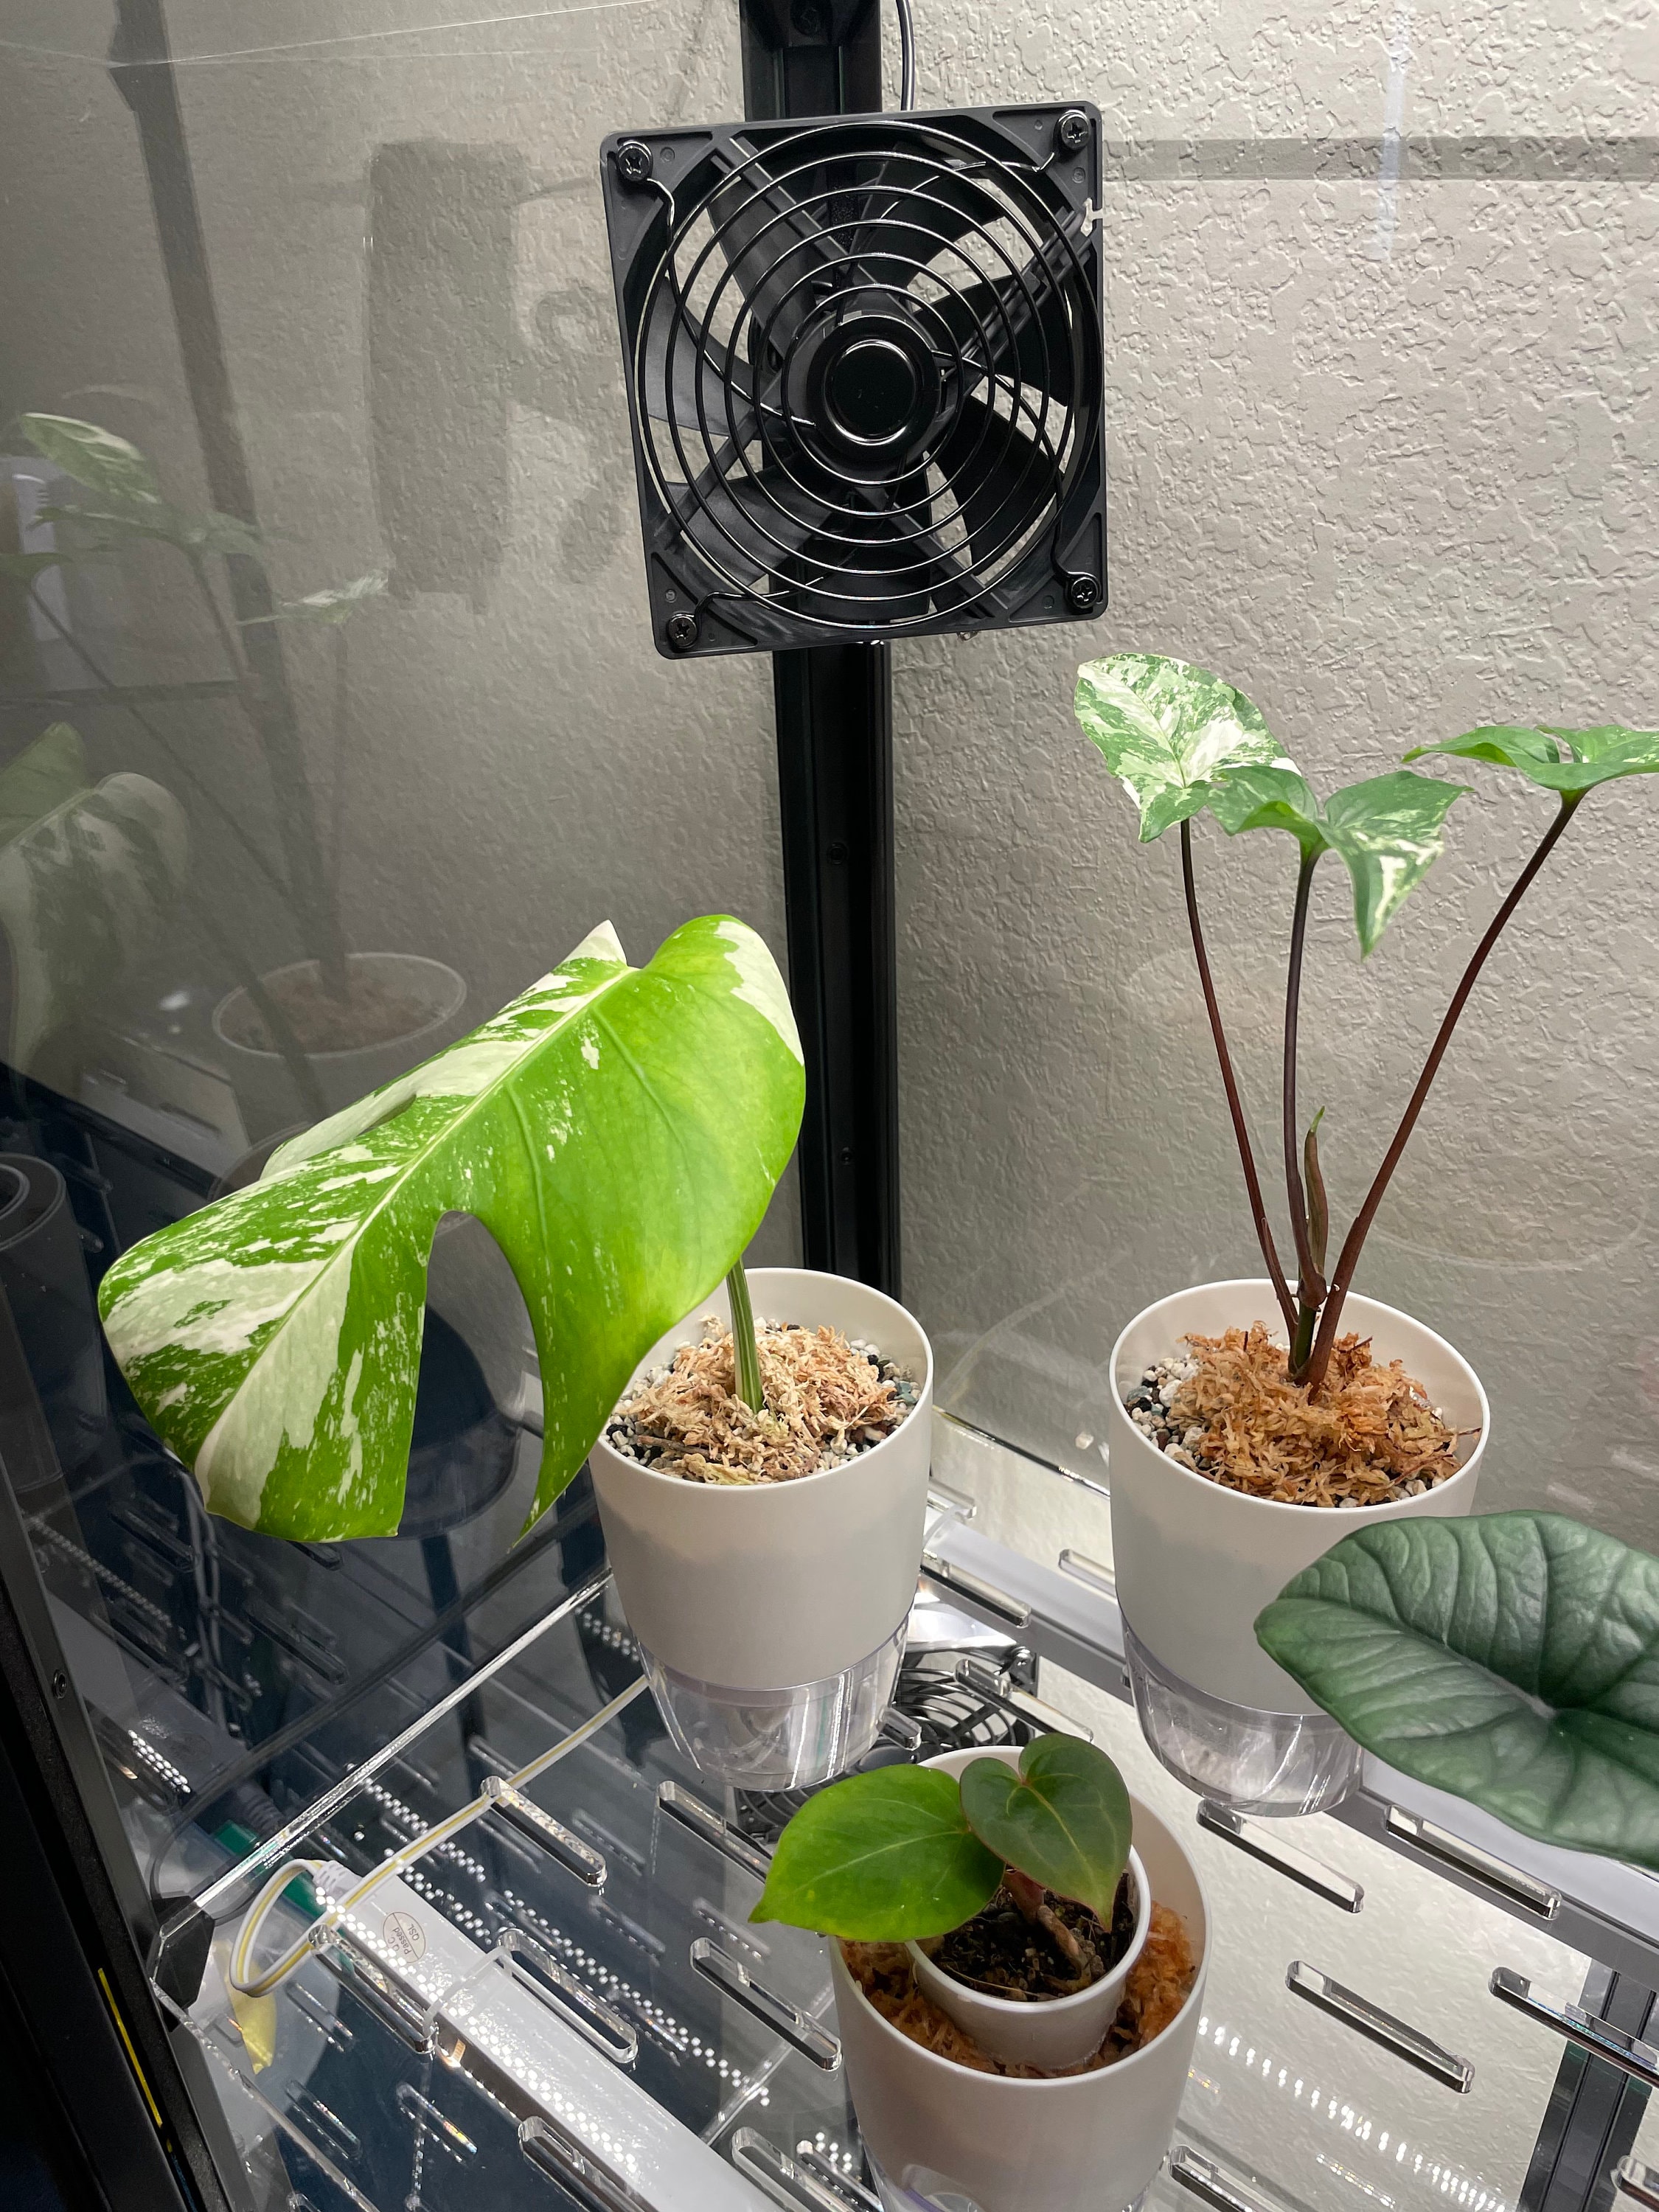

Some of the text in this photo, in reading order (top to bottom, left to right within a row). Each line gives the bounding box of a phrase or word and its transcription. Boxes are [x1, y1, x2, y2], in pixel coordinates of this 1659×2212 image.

[392, 1927, 411, 1955] Passed
[408, 1924, 420, 1941] QSL
[388, 1937, 400, 1951] QC
